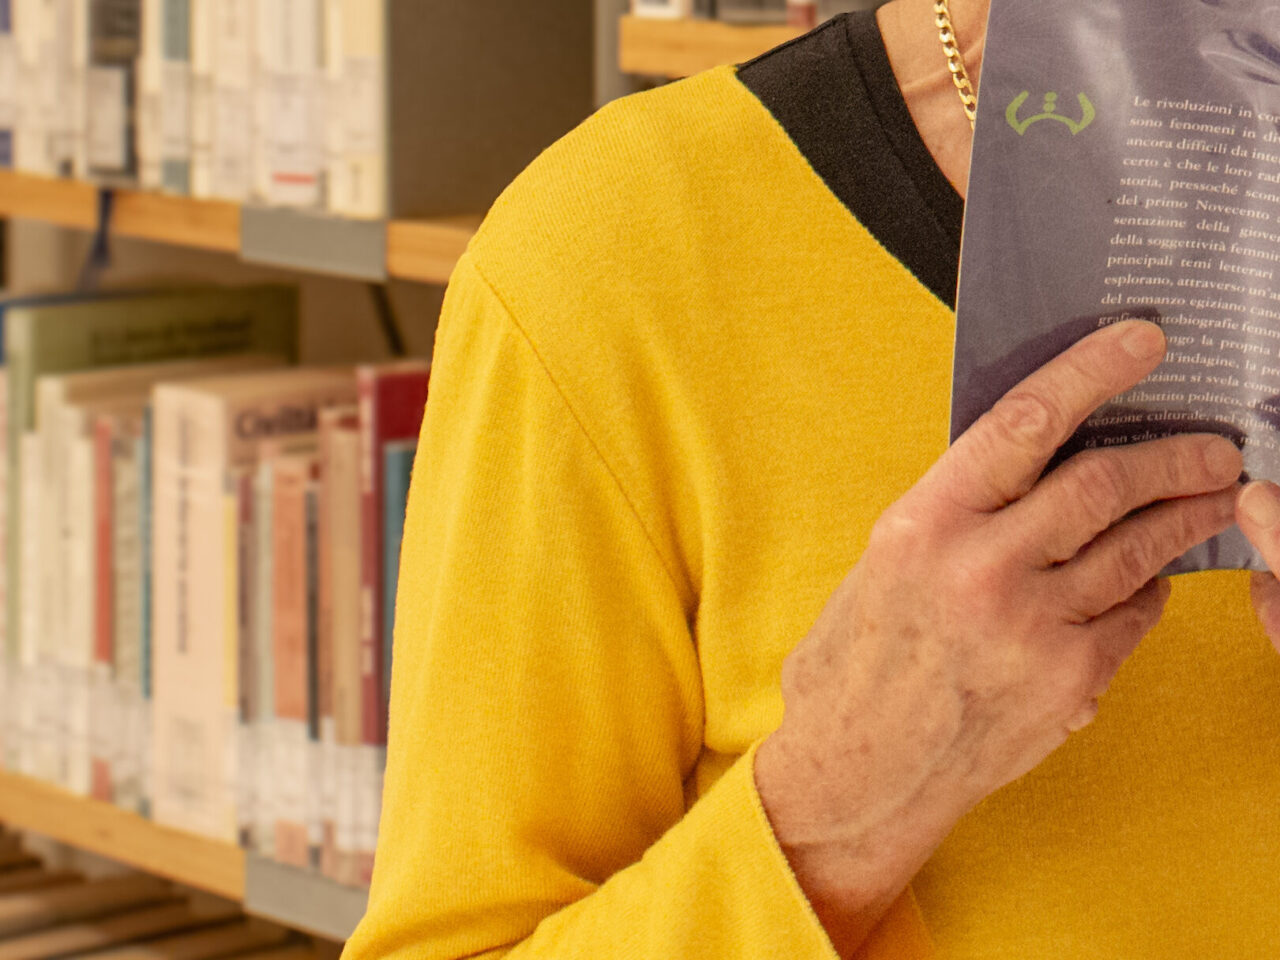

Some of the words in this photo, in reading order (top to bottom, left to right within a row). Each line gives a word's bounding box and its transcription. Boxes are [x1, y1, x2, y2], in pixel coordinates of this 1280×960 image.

[1133, 96, 1151, 108] Le
[1156, 98, 1233, 115] rivoluzioni
[1238, 106, 1253, 119] in
[1128, 117, 1162, 128] sono
[1168, 117, 1235, 136] fenomeni
[1242, 126, 1257, 139] in
[1126, 137, 1173, 150] ancora
[1176, 138, 1228, 155] difficili
[1231, 144, 1249, 158] da
[1122, 157, 1158, 168] certo
[1163, 157, 1172, 169] è
[1176, 159, 1201, 171] che
[1207, 161, 1220, 173] le
[1224, 164, 1252, 178] loro
[1119, 176, 1162, 189] storia,
[1168, 180, 1239, 197] pressoché
[1116, 194, 1138, 207] del
[1144, 196, 1188, 210] primo
[1195, 198, 1271, 221] Novecento
[1113, 216, 1187, 229] sentazione
[1195, 218, 1230, 234] della
[1110, 233, 1143, 246] della
[1146, 237, 1227, 253] soggettività
[1106, 253, 1173, 268] principali
[1180, 256, 1212, 270] temi
[1219, 259, 1273, 281] letterari
[1103, 273, 1174, 288] esplorano,
[1177, 276, 1245, 294] attraverso
[1101, 293, 1122, 305] del
[1126, 296, 1187, 307] romanzo
[1189, 296, 1246, 313] egiziano
[1201, 334, 1214, 347] la
[1220, 338, 1271, 356] propria
[1245, 359, 1258, 373] la
[1190, 371, 1202, 383] si
[1205, 374, 1240, 387] svela
[1243, 379, 1280, 396] come
[1127, 390, 1185, 404] dibattito
[1187, 391, 1243, 406] politico,
[1146, 407, 1210, 423] culturale,
[1214, 411, 1236, 425] nel
[1103, 434, 1128, 448] non
